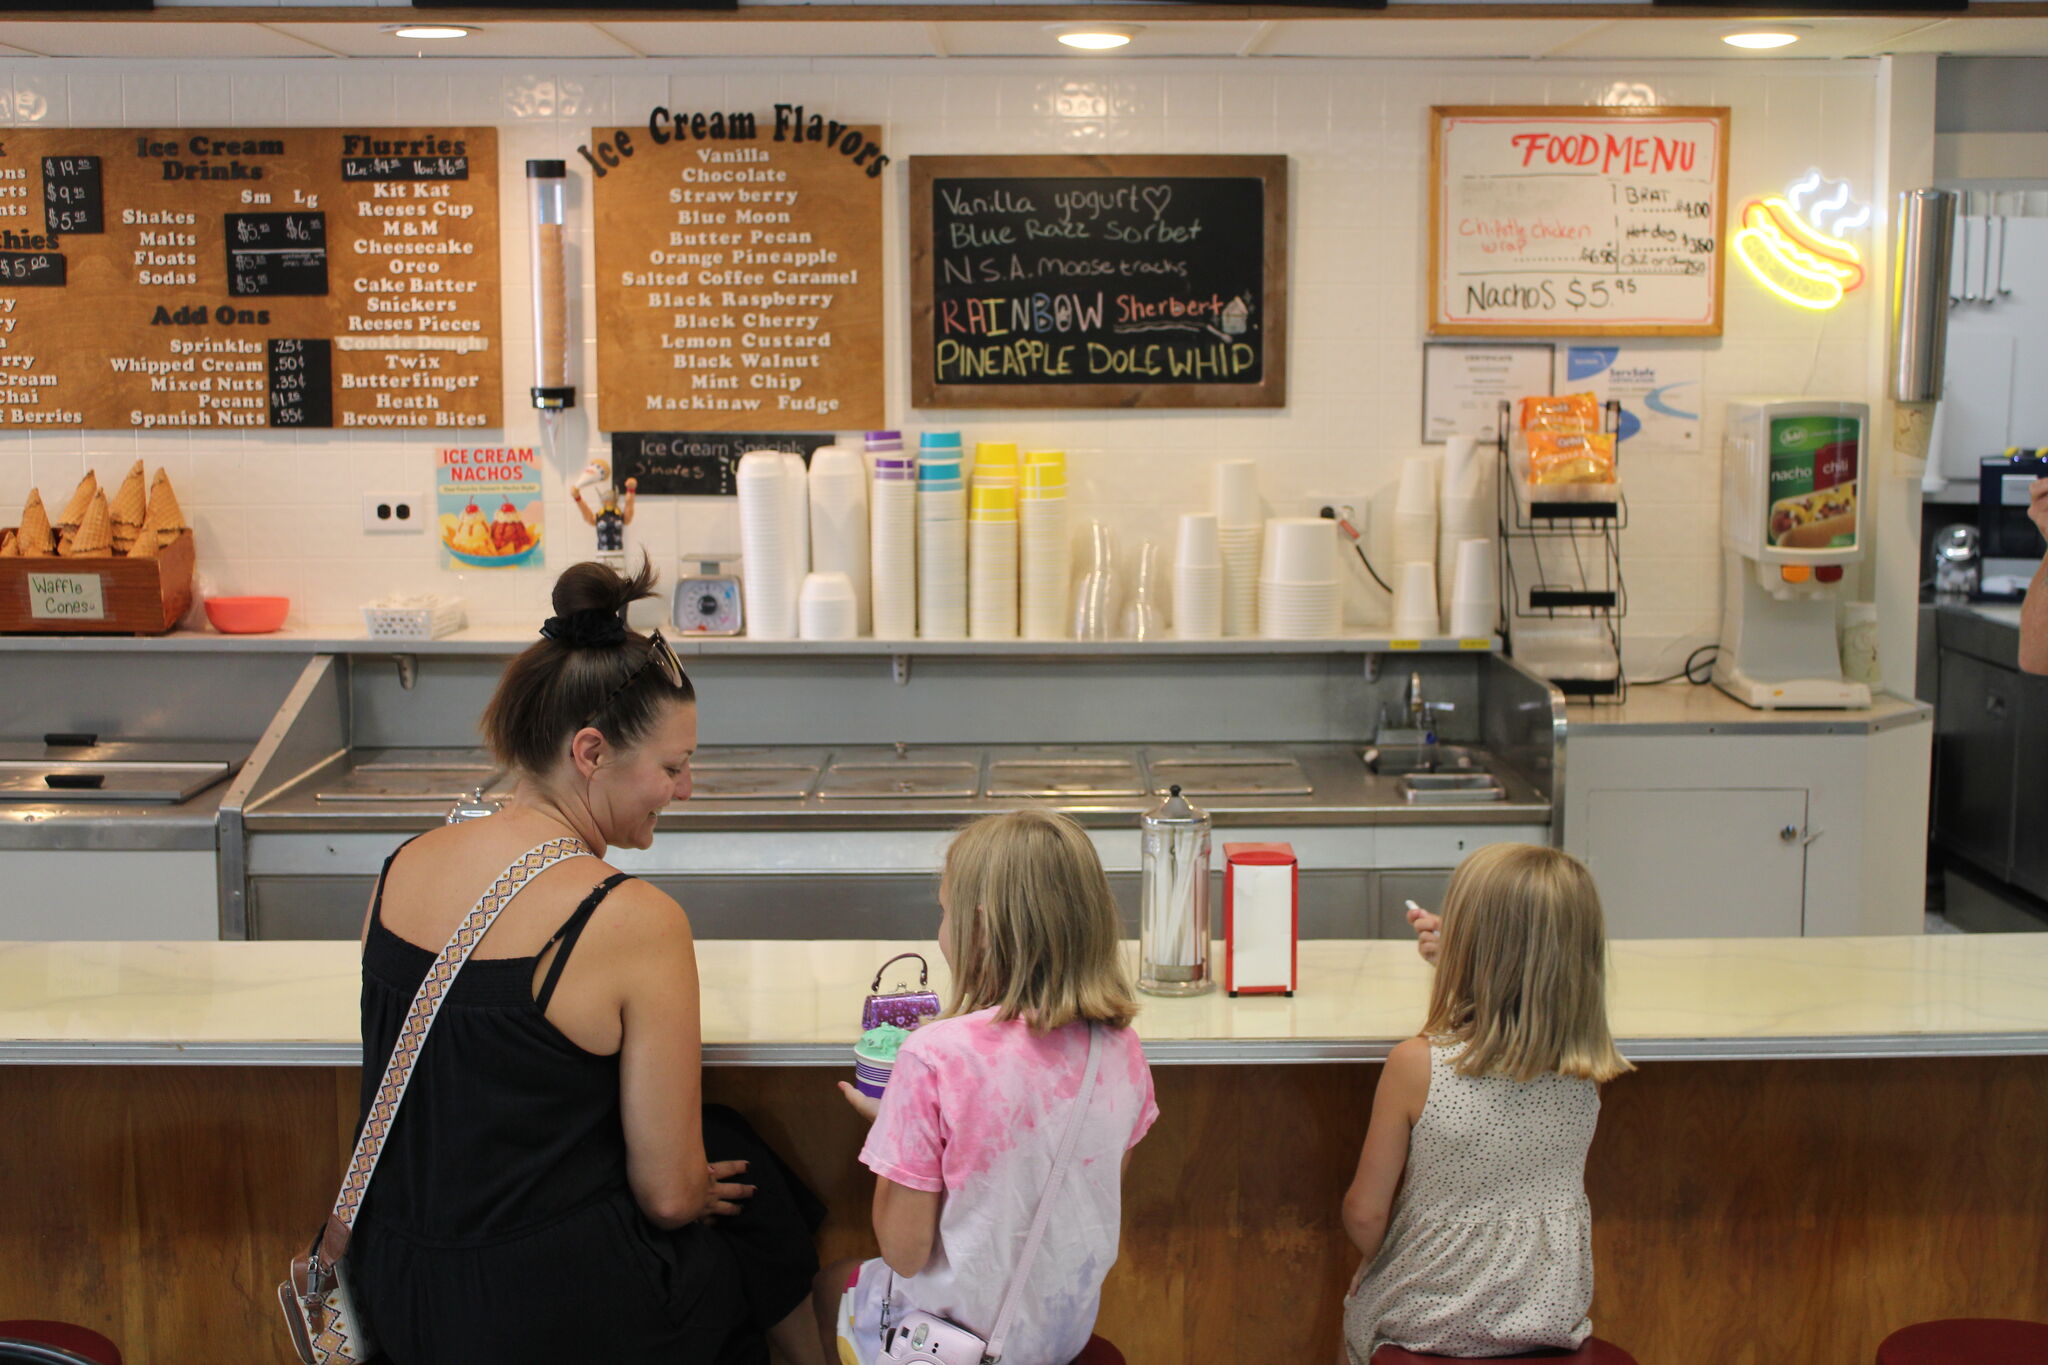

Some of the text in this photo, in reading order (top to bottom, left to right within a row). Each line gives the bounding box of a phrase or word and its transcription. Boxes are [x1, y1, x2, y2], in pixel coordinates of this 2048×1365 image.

[136, 136, 284, 157] Ice Cream
[342, 135, 466, 155] Flurries
[577, 104, 890, 178] Ice Cream Flavors
[696, 148, 769, 163] Vanilla
[1511, 133, 1696, 175] FOOD MENU
[162, 161, 263, 181] Drinks
[681, 168, 786, 183] Chocolate
[241, 189, 318, 208] Sm Lg
[373, 183, 451, 199] Kit Kat
[669, 188, 798, 205] Strawberry
[358, 201, 474, 219] Reeses Cup
[941, 185, 1141, 223] Vanilla yogurt
[122, 208, 196, 225] Shakes
[678, 209, 791, 225] Blue Moon
[383, 220, 438, 236] M & M
[950, 218, 1203, 249] Blue Razz Sorbet
[0, 228, 60, 250] hies
[140, 231, 196, 246] Malts
[669, 230, 812, 246] Butter Pecan
[353, 239, 474, 255] Cheesecake
[134, 251, 197, 266] Floats
[389, 258, 440, 274] Oreo
[650, 248, 838, 268] Orange Pineapple
[139, 270, 197, 285] Sodas
[353, 277, 477, 293] Cake Batter
[622, 269, 858, 286] Salted Coffee Caramel
[367, 296, 457, 313] Snickers
[648, 291, 833, 309] Black Raspberry
[151, 306, 270, 325] Add Ons
[674, 313, 820, 330] Black Cherry
[942, 292, 1224, 337] RAINBOW Sherbert
[348, 315, 481, 332] Reeses Pieces
[170, 337, 262, 355] Sprinkles
[661, 332, 832, 349] Lemon Custard
[110, 357, 263, 375] Whipped Cream
[385, 353, 440, 369] Twix
[673, 353, 820, 369] Black Walnut
[937, 338, 1254, 380] PINEAPPLE DOLE WHIP
[151, 376, 264, 392] Mixed Nuts
[341, 372, 479, 392] Butterfinger
[691, 374, 802, 391] Mint Chip
[198, 393, 264, 409] Pecans
[376, 393, 440, 409] Heath
[646, 395, 839, 415] Mackinaw Fudge
[11, 408, 82, 424] Berries
[130, 410, 266, 428] Spanish Nuts
[343, 410, 487, 427] Brownie Bites
[443, 448, 534, 464] ICE CREAM
[640, 439, 666, 456] Ice
[671, 439, 728, 456] Cream
[451, 465, 524, 481] NACHOS
[1771, 465, 1813, 482] nacho
[1822, 457, 1849, 475] chili
[32, 577, 82, 594] Waffle
[45, 597, 88, 614] Cones
